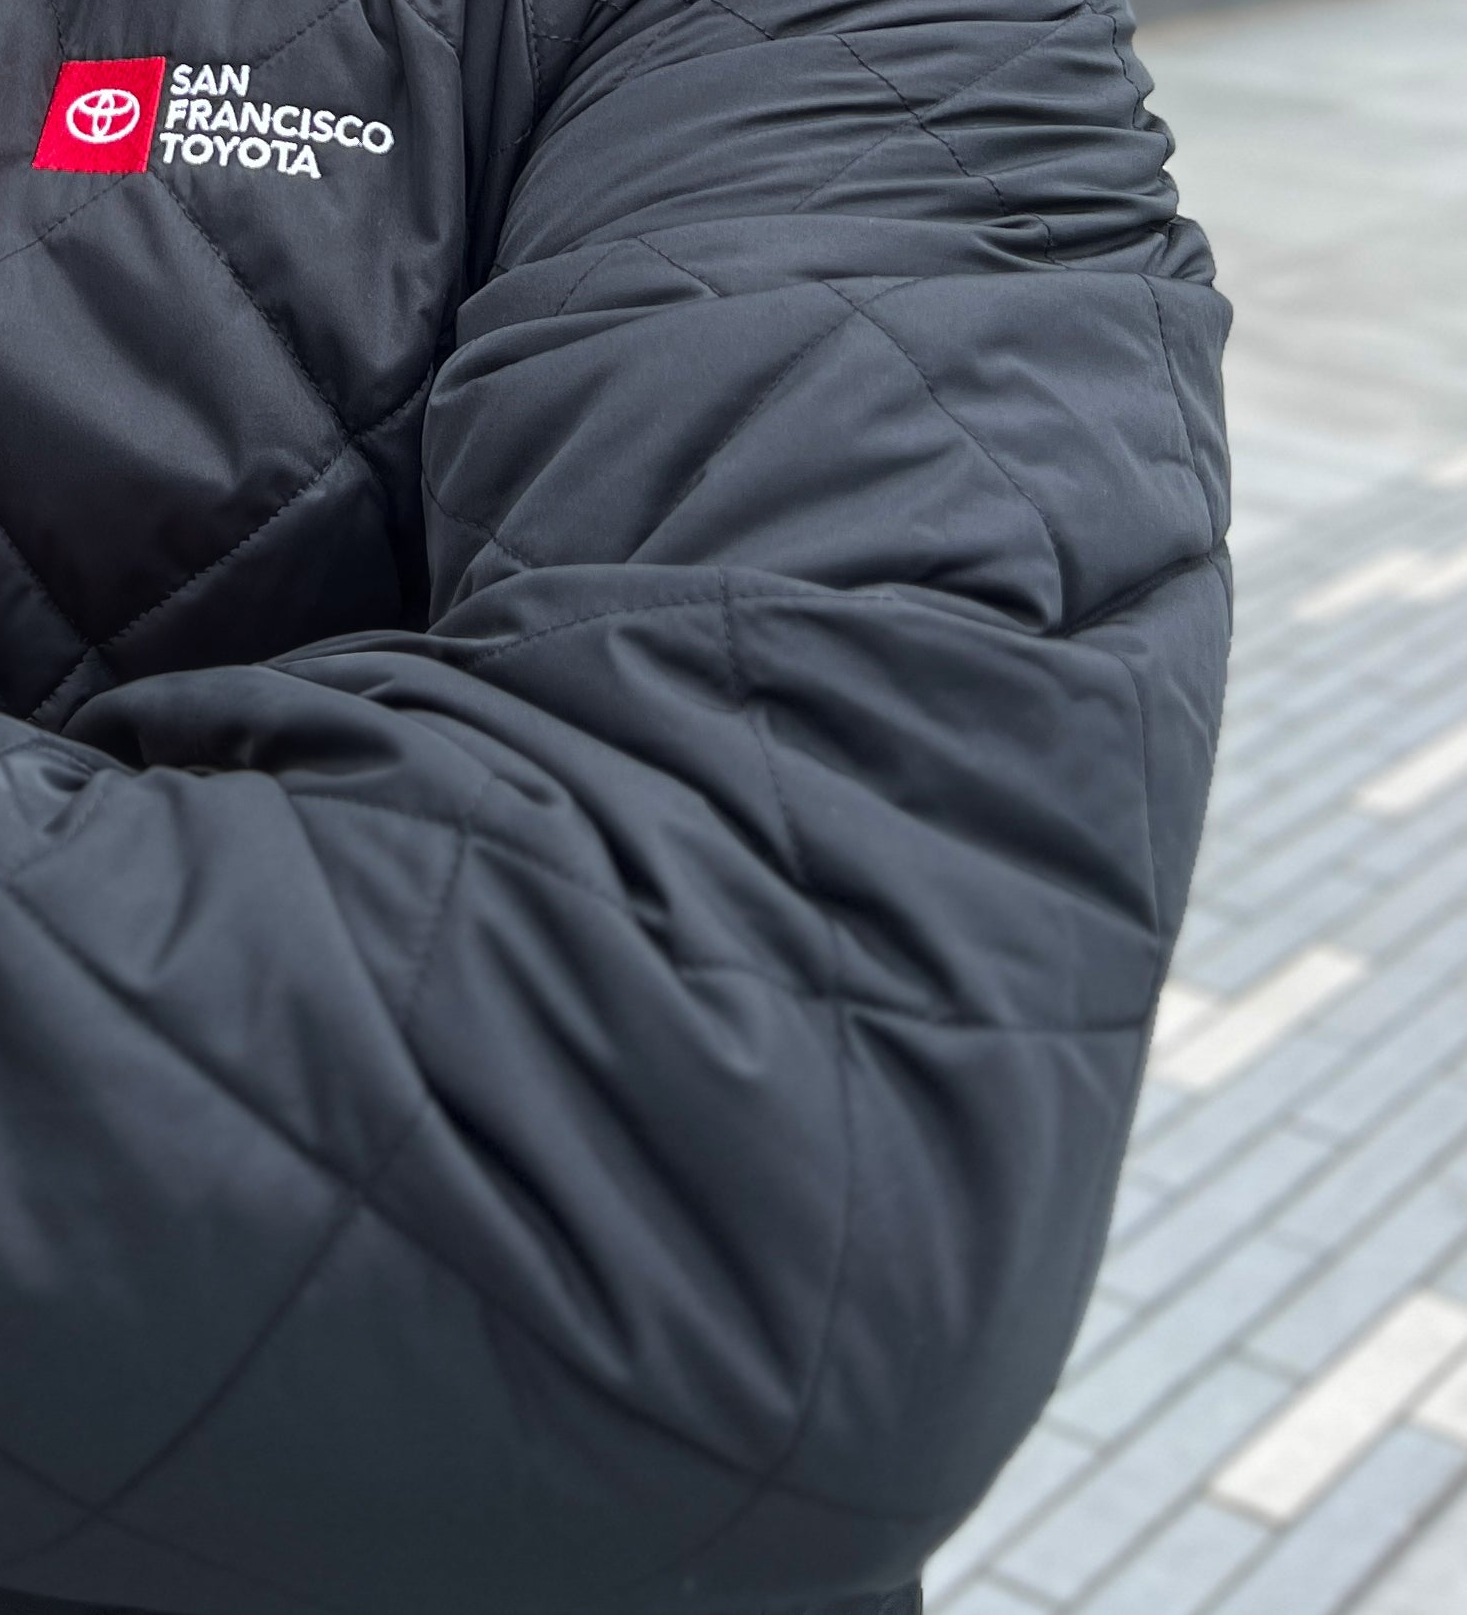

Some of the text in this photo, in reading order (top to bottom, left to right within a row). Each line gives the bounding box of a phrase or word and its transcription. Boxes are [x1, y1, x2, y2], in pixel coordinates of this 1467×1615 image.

[170, 63, 250, 96] SAN
[164, 99, 395, 154] FRANCISCO
[159, 132, 322, 180] TOYOTA
